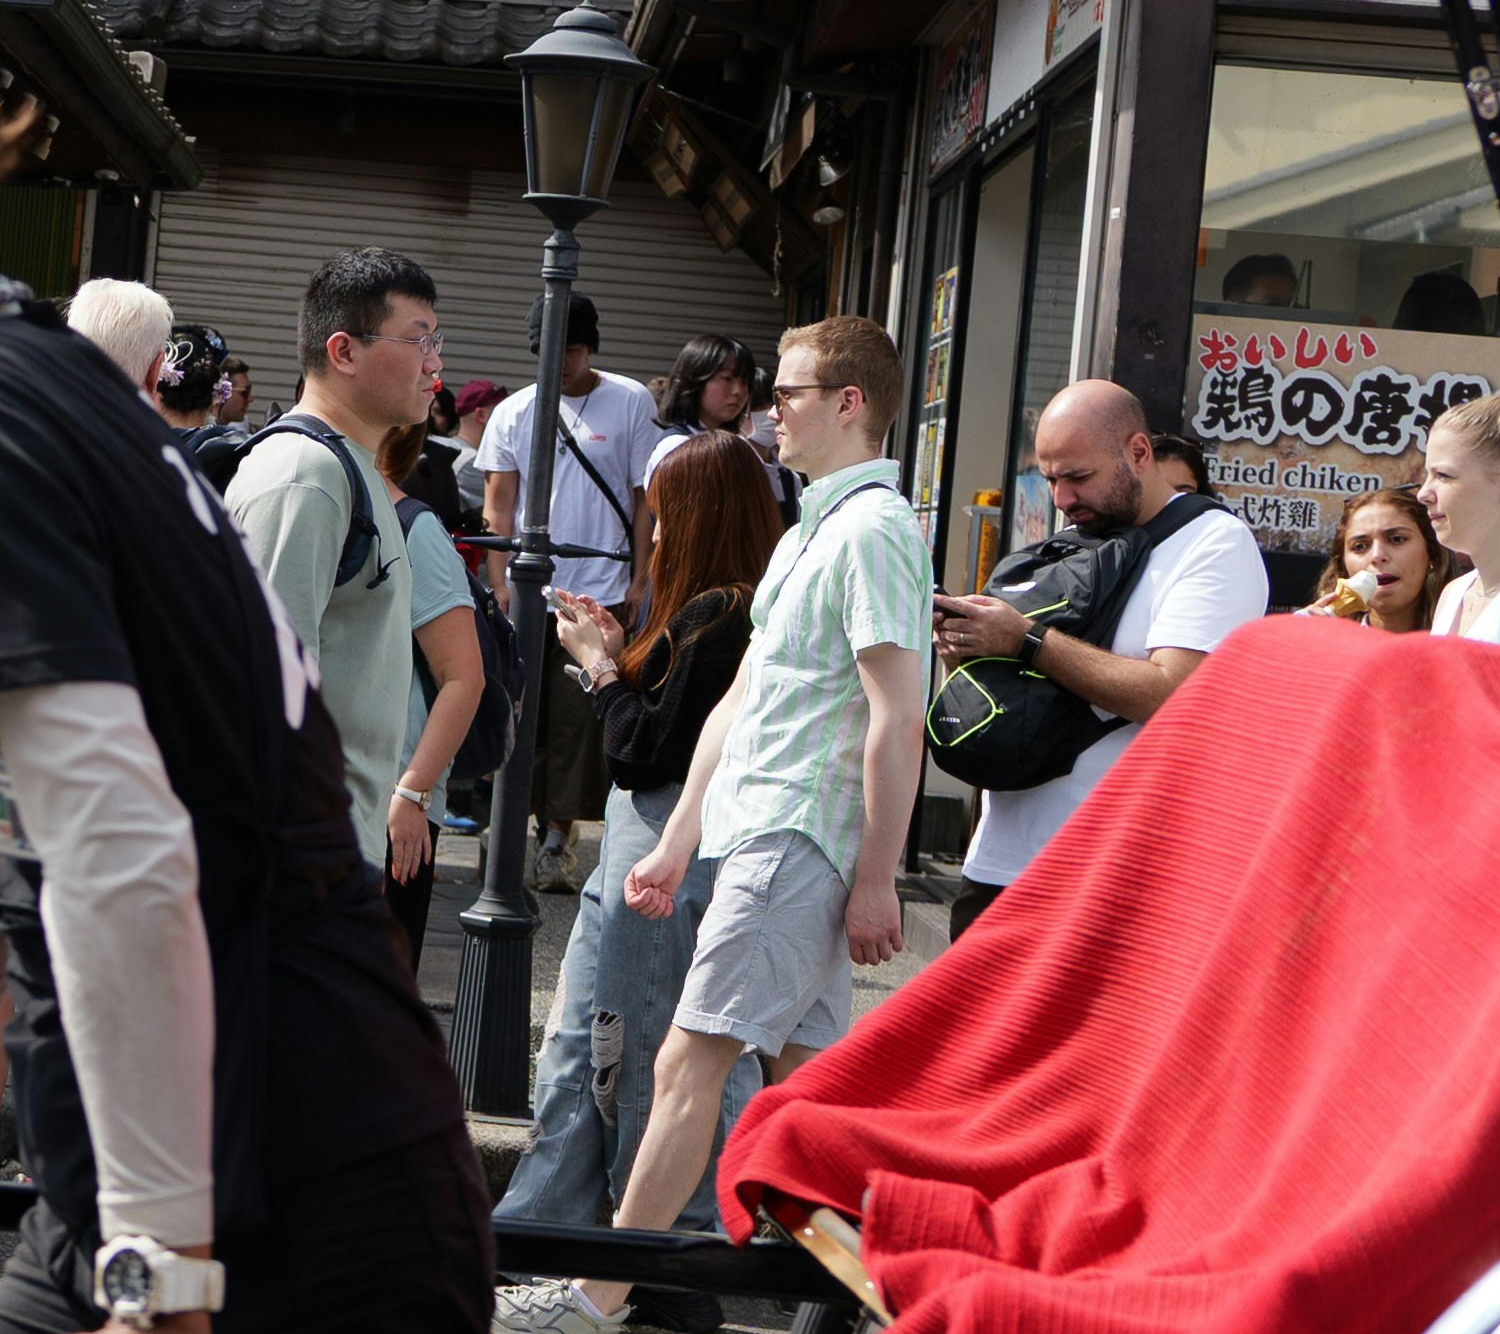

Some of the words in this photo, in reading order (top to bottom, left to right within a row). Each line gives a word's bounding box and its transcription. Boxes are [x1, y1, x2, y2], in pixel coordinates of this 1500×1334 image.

[1200, 328, 1377, 370] おいしい
[1203, 456, 1276, 485] Fried
[1284, 464, 1381, 493] chiken
